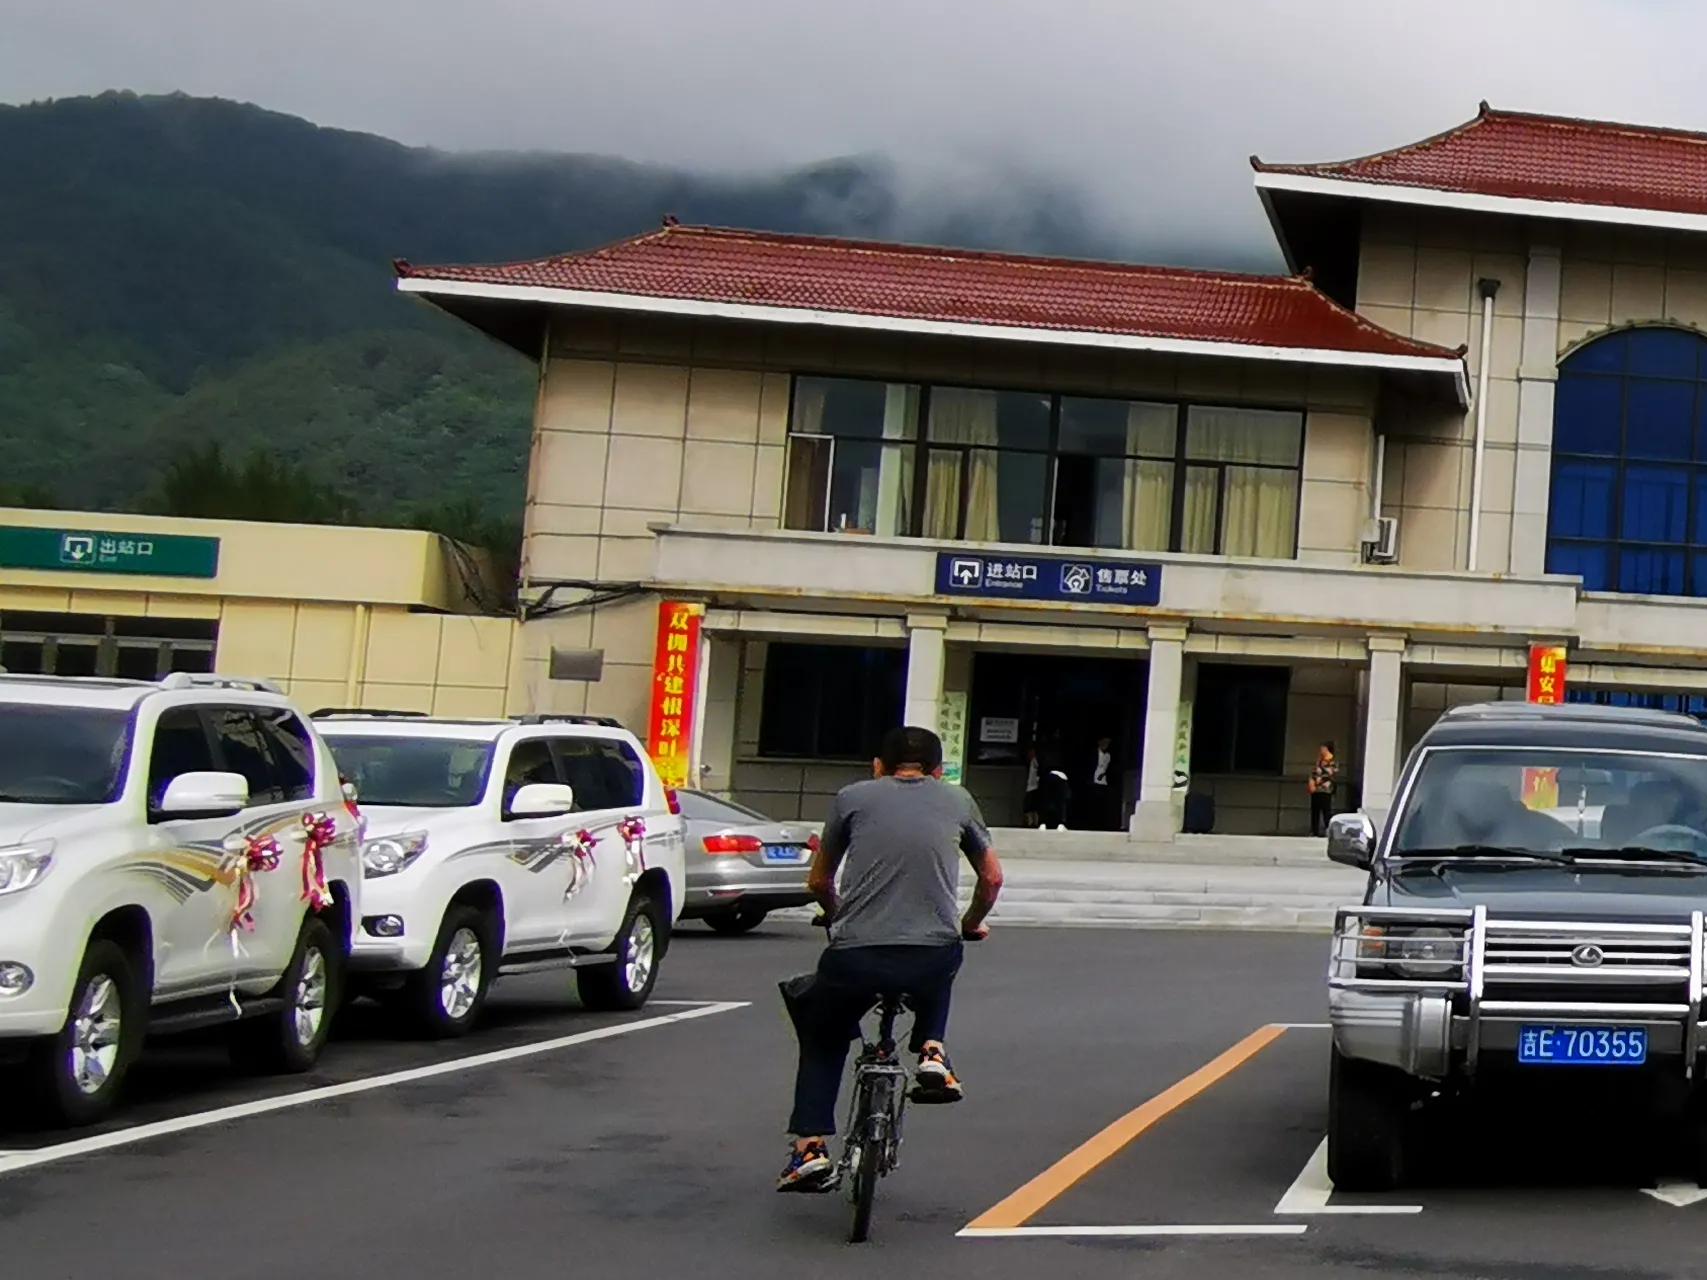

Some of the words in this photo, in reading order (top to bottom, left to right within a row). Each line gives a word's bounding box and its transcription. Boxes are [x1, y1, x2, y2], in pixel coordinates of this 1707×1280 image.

[100, 538, 154, 555] 出站口
[986, 562, 1038, 580] 进站口
[1096, 568, 1148, 586] 售票处
[658, 611, 689, 778] 双拥共建根深叶
